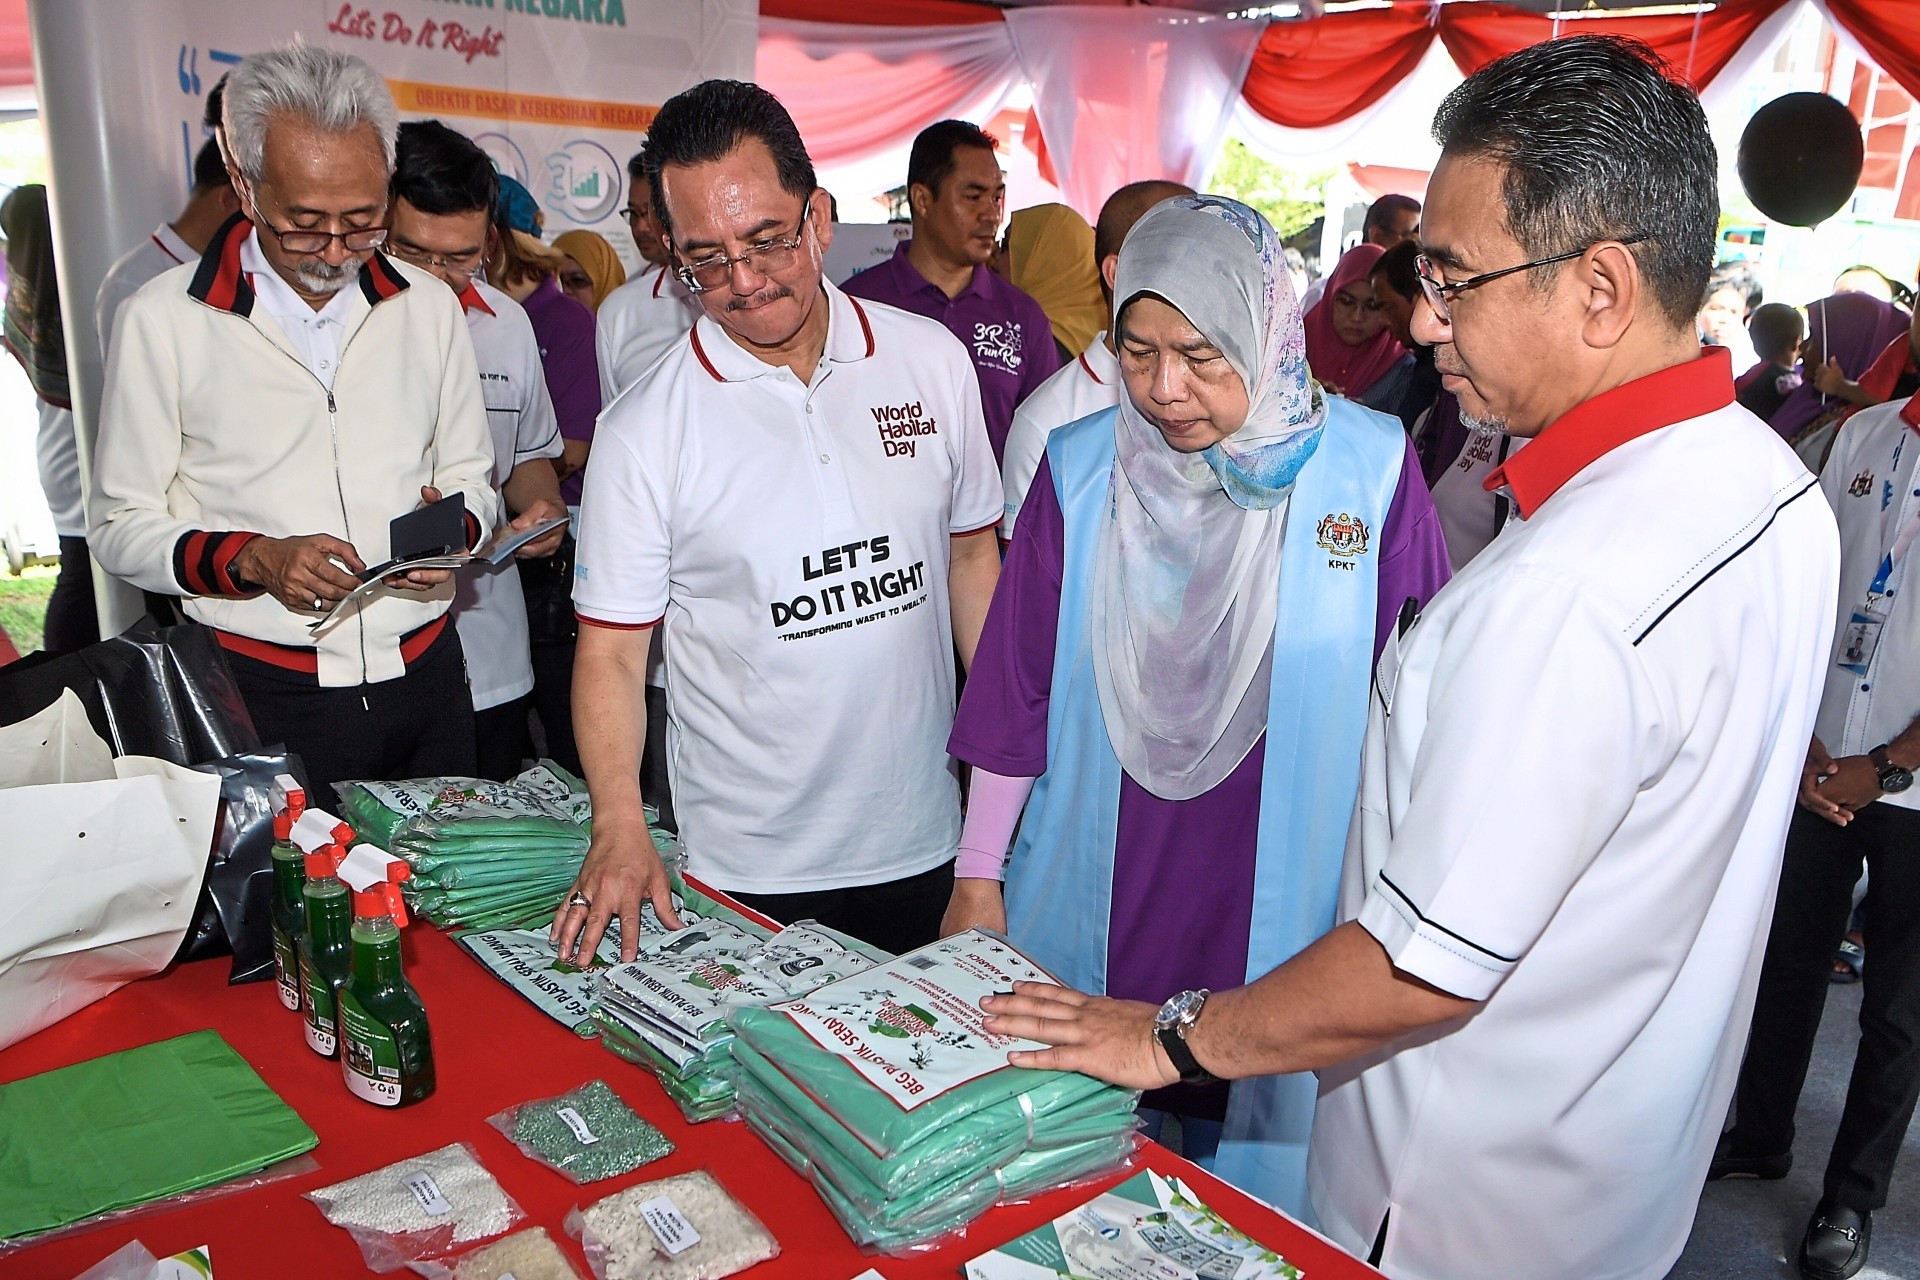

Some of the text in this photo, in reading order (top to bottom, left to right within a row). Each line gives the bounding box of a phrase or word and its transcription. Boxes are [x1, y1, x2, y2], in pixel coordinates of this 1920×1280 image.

[328, 3, 504, 64] Let's Do It Right
[416, 88, 652, 126] OBJEKTIF DASAR KEBERSIHAN NEGARA
[973, 323, 1008, 347] 3R
[973, 341, 999, 358] Fun
[998, 346, 1022, 368] Run
[870, 400, 923, 423] World
[878, 417, 938, 440] Habitat
[883, 440, 916, 458] Day
[1473, 435, 1494, 448] orld
[1457, 456, 1475, 473] ay
[1466, 445, 1493, 463] abitat
[802, 535, 890, 581] LET'S
[1328, 559, 1356, 571] KPKT
[770, 560, 924, 628] DO IT RIGHT
[855, 610, 886, 626] WASTE
[889, 607, 900, 617] TO
[478, 933, 515, 959] WANGI
[507, 956, 536, 977] SERAI
[965, 952, 1003, 976] ANARICH
[528, 972, 572, 1002] PLASTIK
[622, 964, 703, 1017] BEG PLASTIK SERAI WANGI
[823, 1016, 858, 1045] SERAI
[852, 1041, 899, 1075] PLASTIK
[894, 1071, 923, 1095] BEG
